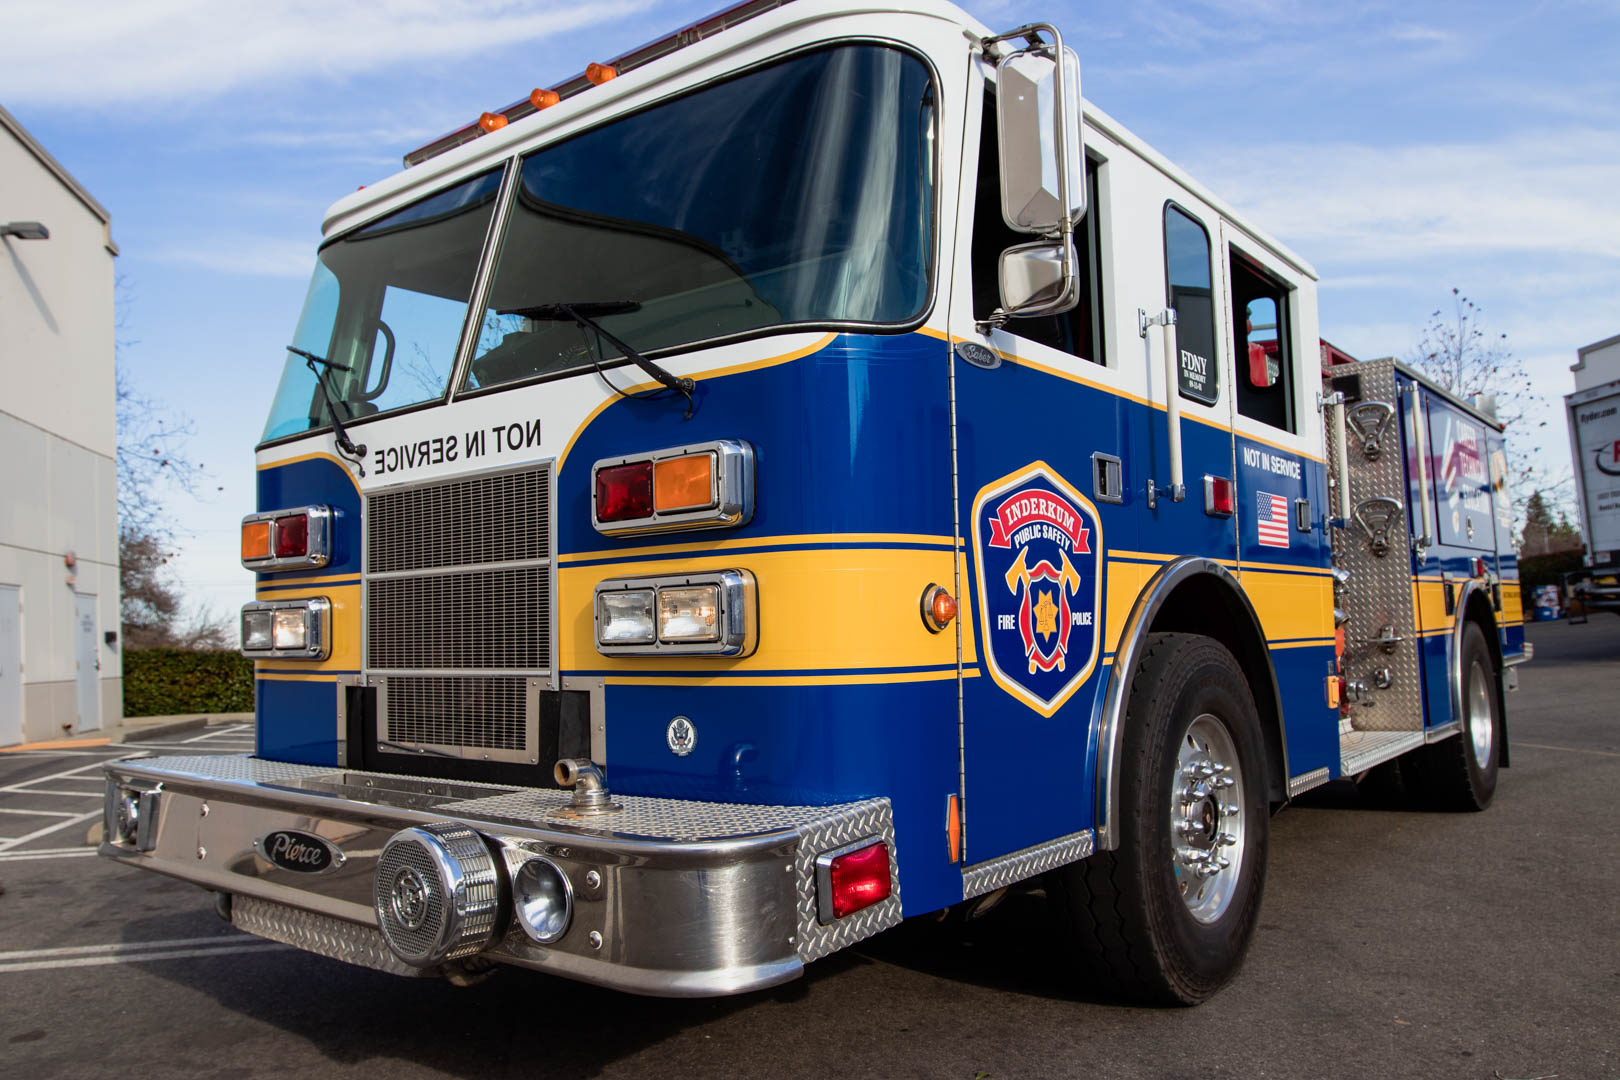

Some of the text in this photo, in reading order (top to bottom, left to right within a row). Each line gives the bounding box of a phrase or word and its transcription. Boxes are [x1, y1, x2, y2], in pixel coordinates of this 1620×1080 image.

[1181, 349, 1207, 376] FDNY
[1189, 371, 1207, 384] MEMORY
[1243, 447, 1301, 480] NOT IN SERVICE
[1005, 498, 1075, 533] INDERKUM
[1014, 524, 1071, 551] PUBLIC SAFETY
[998, 614, 1016, 630] FIRE
[1072, 612, 1093, 626] POLICE
[271, 833, 322, 865] Pierce
